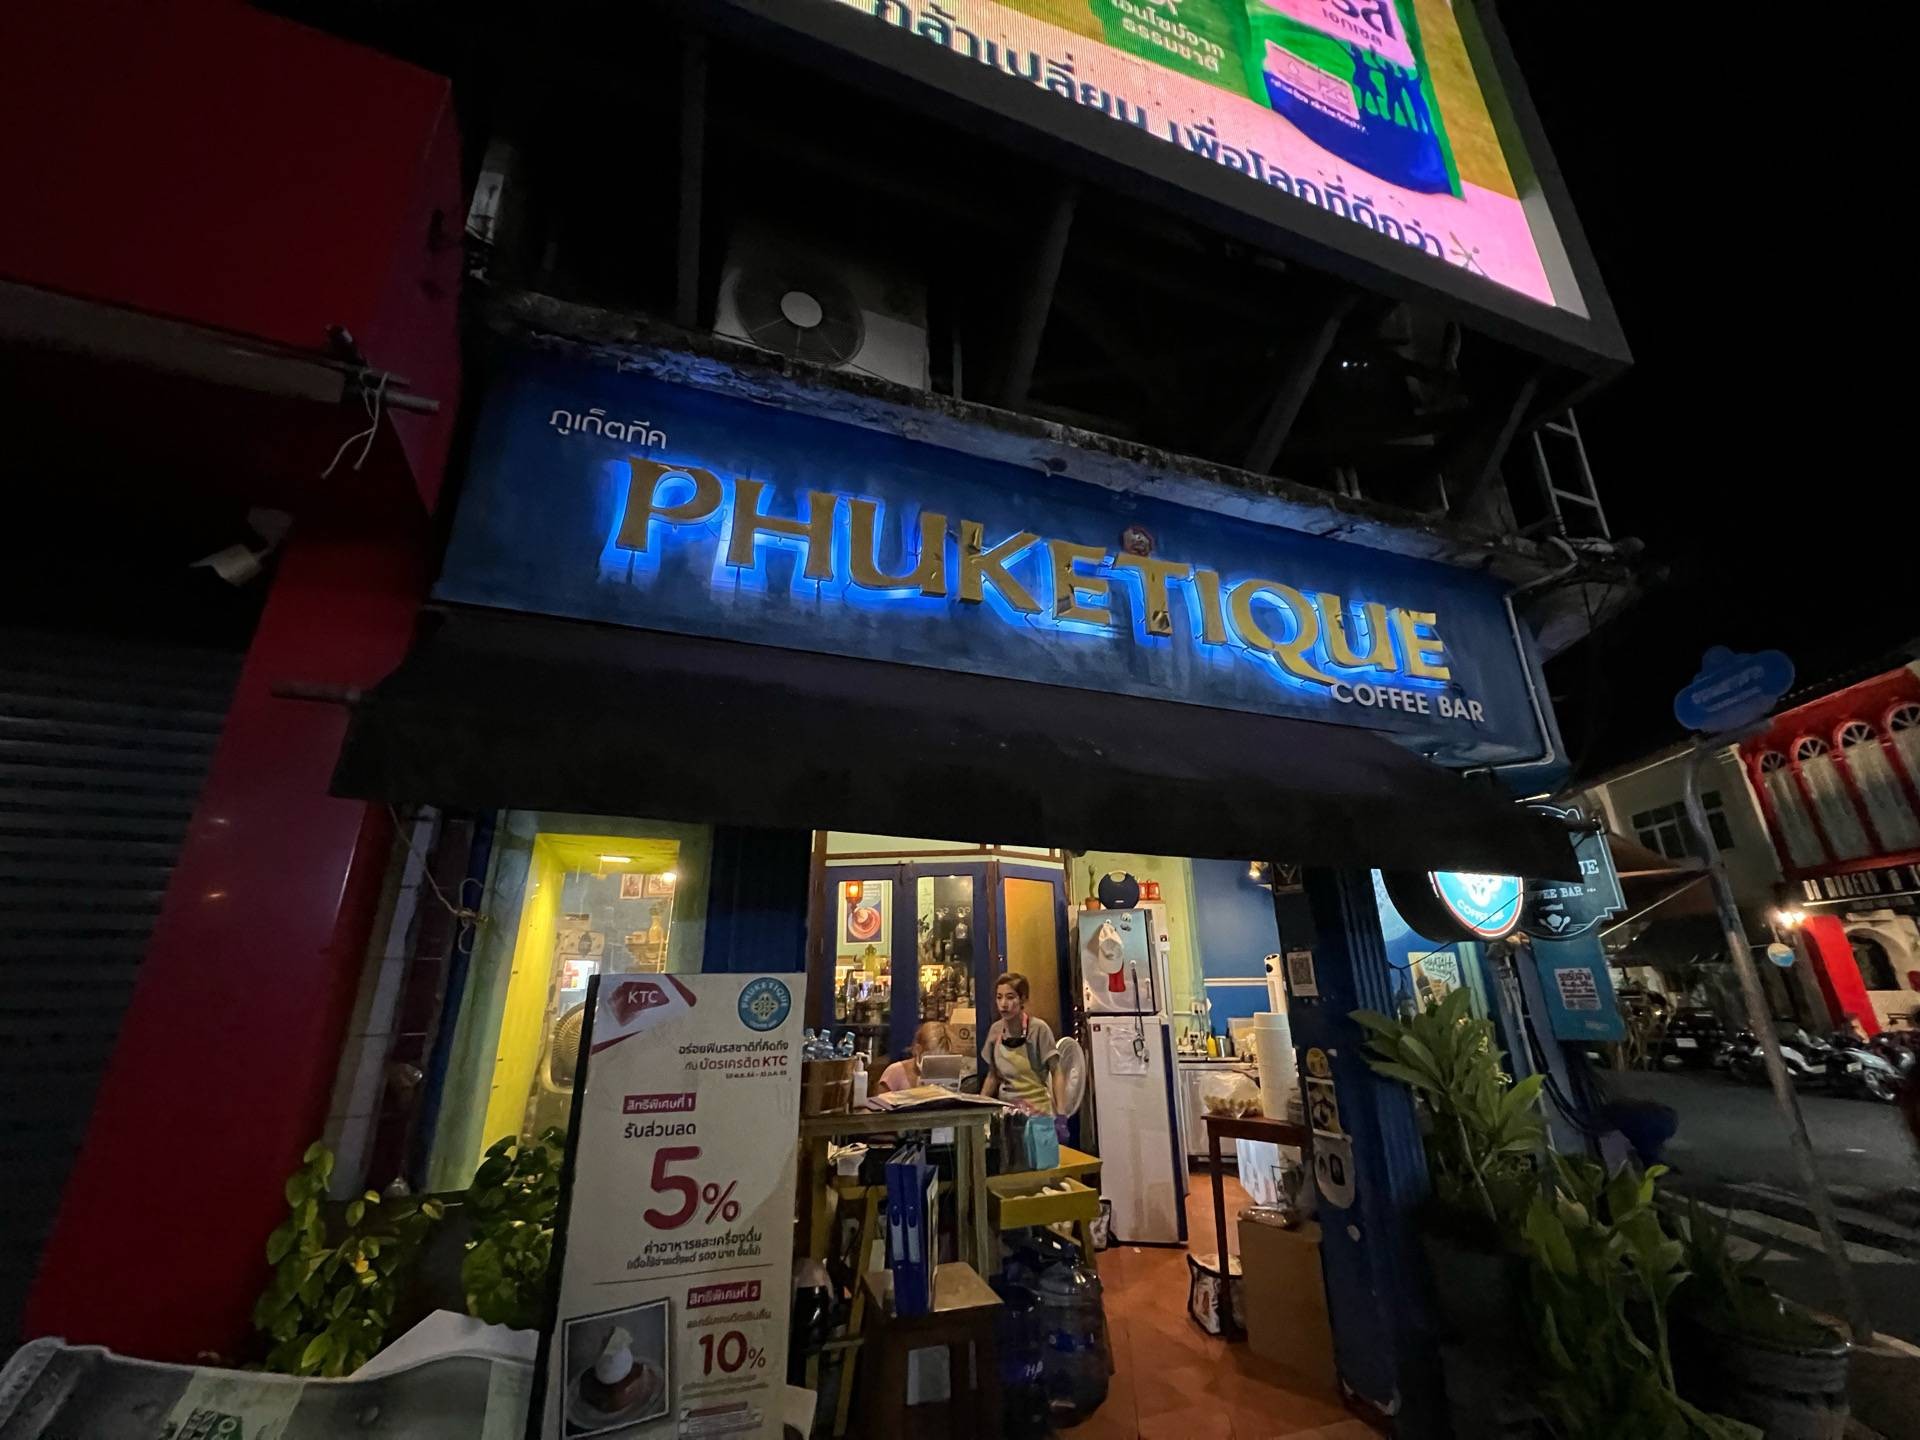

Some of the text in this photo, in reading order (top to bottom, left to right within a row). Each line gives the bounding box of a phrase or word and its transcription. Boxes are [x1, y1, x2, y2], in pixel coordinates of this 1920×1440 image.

[549, 408, 667, 450] ภูเก็ตทีค
[615, 457, 1451, 686] PHUKETIQUE
[1331, 681, 1485, 723] COFFEE BAR
[1559, 886, 1584, 898] BAR
[627, 990, 659, 1005] KTC
[763, 1055, 788, 1067] KTC
[624, 1120, 697, 1138] รับส่วนลด
[643, 1146, 740, 1230] 5%
[698, 1330, 767, 1376] 10%
